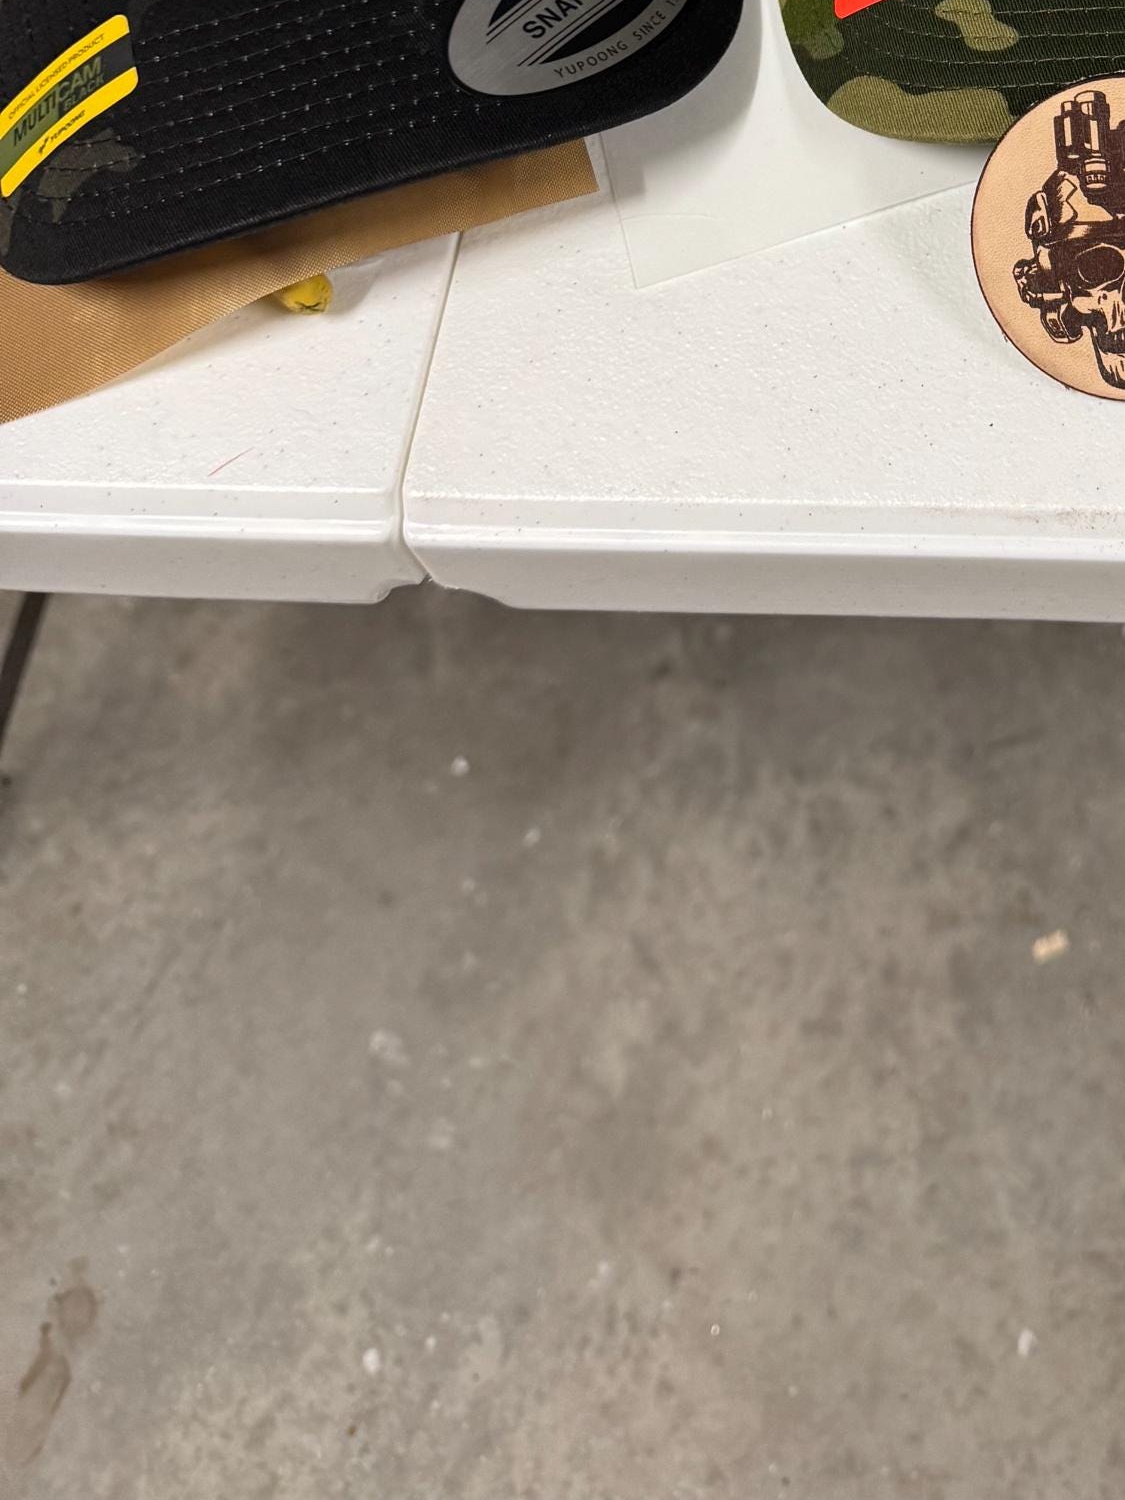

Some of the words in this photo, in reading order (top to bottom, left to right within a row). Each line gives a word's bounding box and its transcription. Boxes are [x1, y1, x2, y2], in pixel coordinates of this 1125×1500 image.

[8, 92, 35, 120] OFFICIAL
[36, 63, 68, 92] LICENSED
[68, 33, 105, 64] PRODUCT
[553, 40, 629, 78] YUPOONG
[633, 11, 667, 41] SINCE
[13, 56, 101, 147] MULTICAM
[64, 73, 105, 111] BLACK
